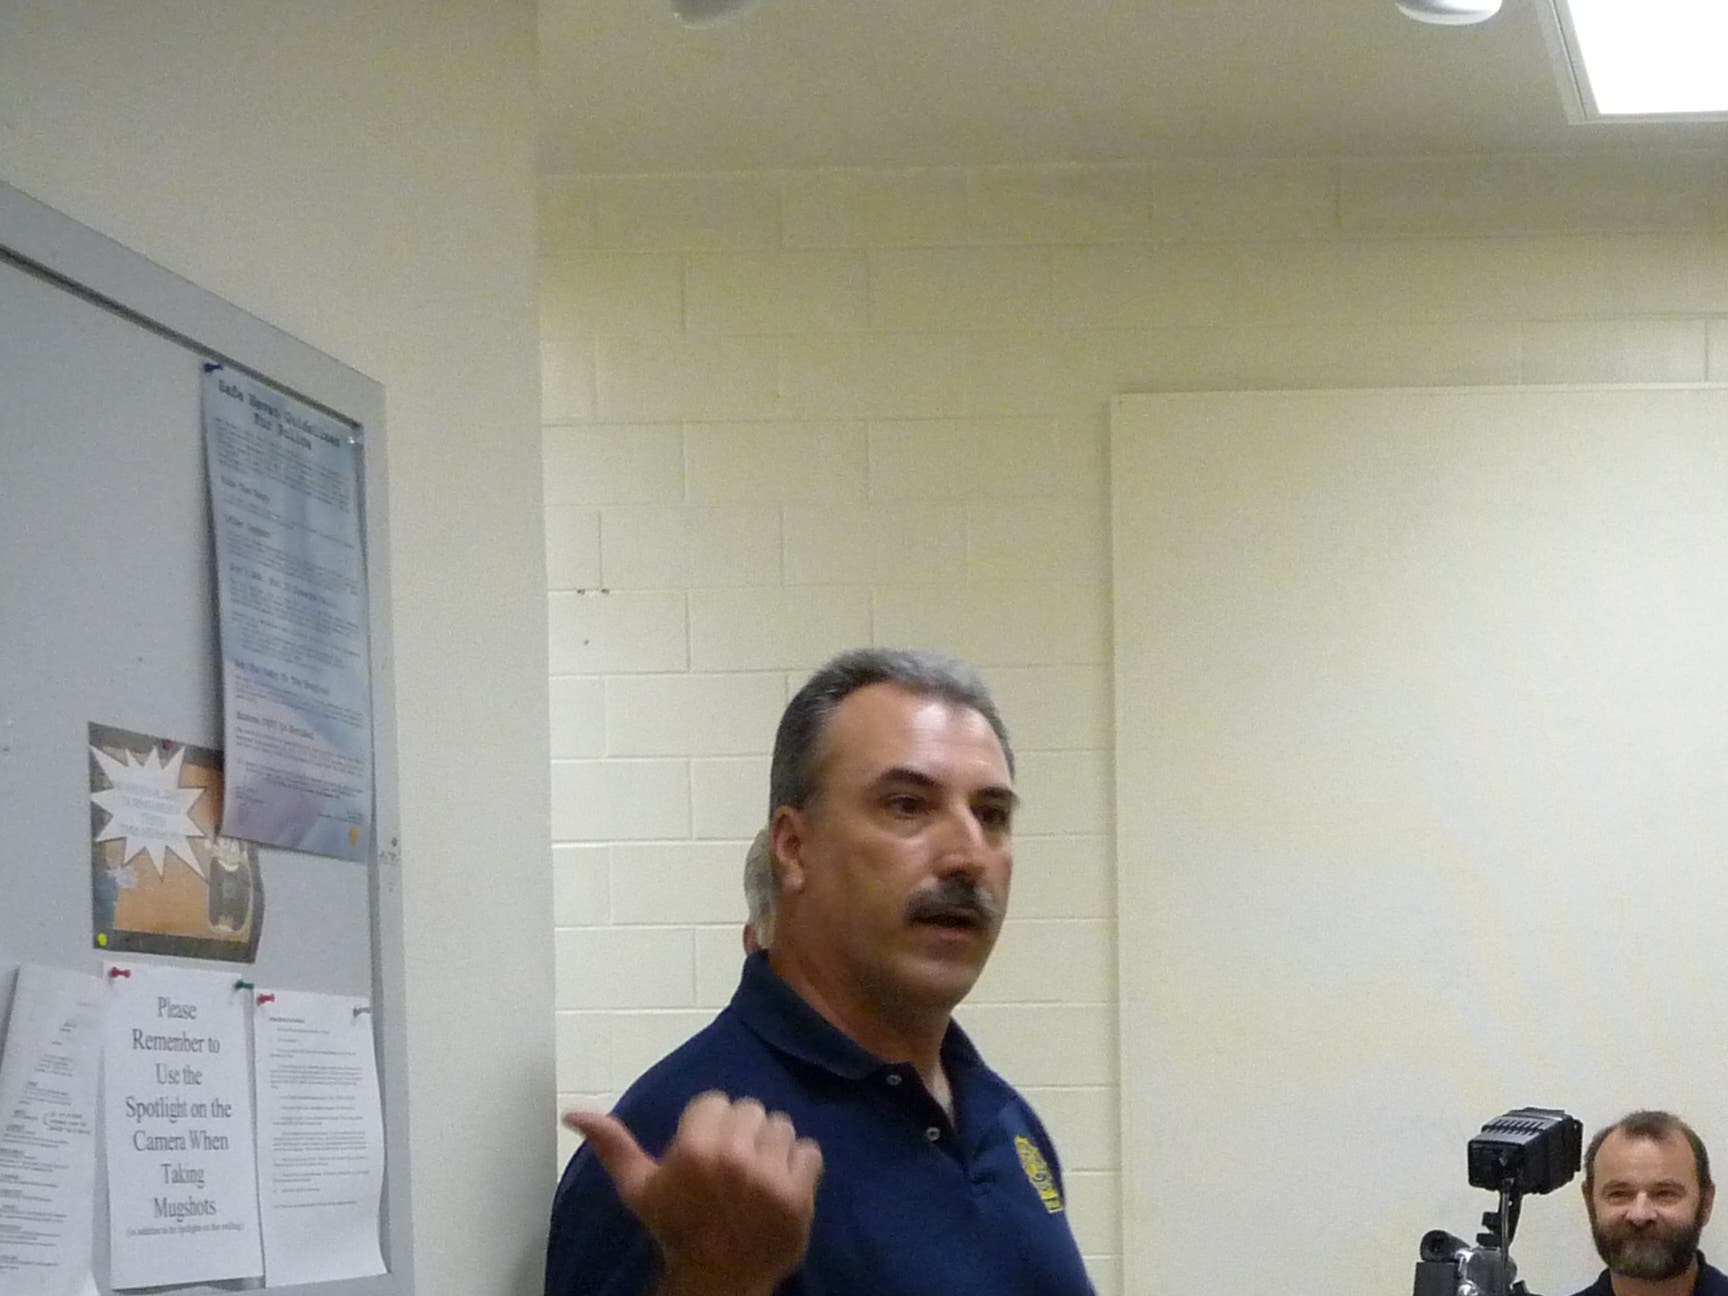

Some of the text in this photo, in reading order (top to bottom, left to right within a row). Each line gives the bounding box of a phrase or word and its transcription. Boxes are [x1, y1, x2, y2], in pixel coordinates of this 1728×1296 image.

[157, 996, 197, 1020] Please
[132, 1028, 221, 1053] Remember to
[156, 1063, 203, 1085] Use the
[125, 1096, 233, 1124] Spotlight on the
[133, 1129, 229, 1151] Camera When
[160, 1163, 205, 1189] Taking
[153, 1195, 217, 1223] Mugshots
